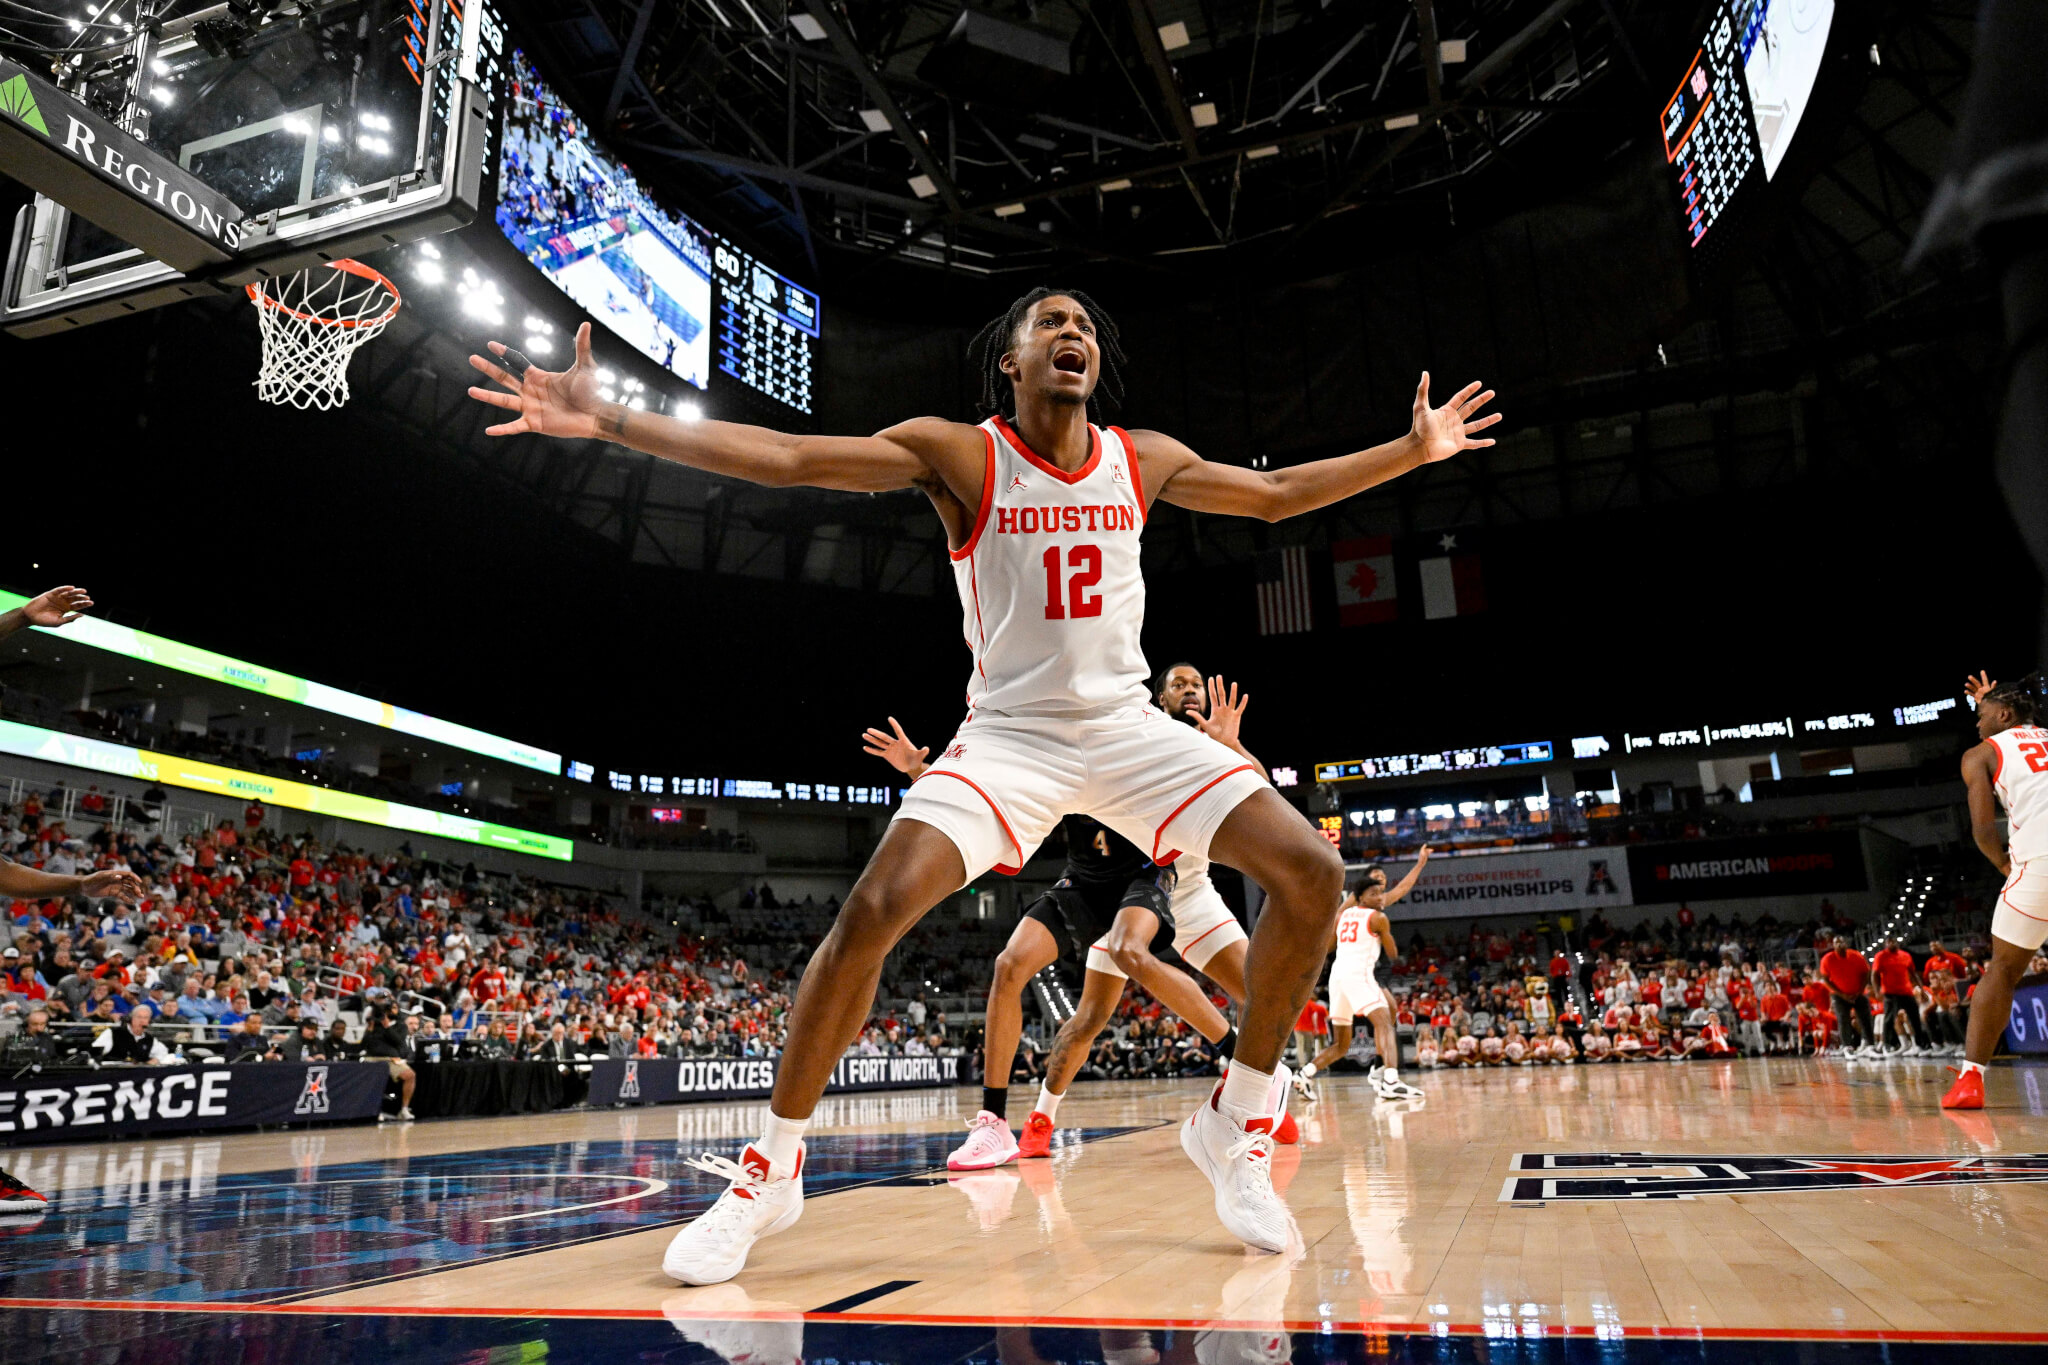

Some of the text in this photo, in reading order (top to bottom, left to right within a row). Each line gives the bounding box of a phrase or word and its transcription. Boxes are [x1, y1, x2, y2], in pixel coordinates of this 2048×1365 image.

[62, 113, 241, 251] REGIONS
[997, 504, 1135, 535] HOUSTON
[1043, 544, 1103, 621] 12
[74, 744, 159, 779] REGIONS
[2017, 741, 2048, 774] 2
[1092, 829, 1112, 857] 4
[1457, 867, 1543, 884] CONFERENCE
[1410, 879, 1574, 905] CHAMPIONSHIPS
[1340, 920, 1360, 943] 23
[678, 1060, 774, 1093] DICKIES
[849, 1058, 888, 1084] FORT
[942, 1056, 958, 1080] TX
